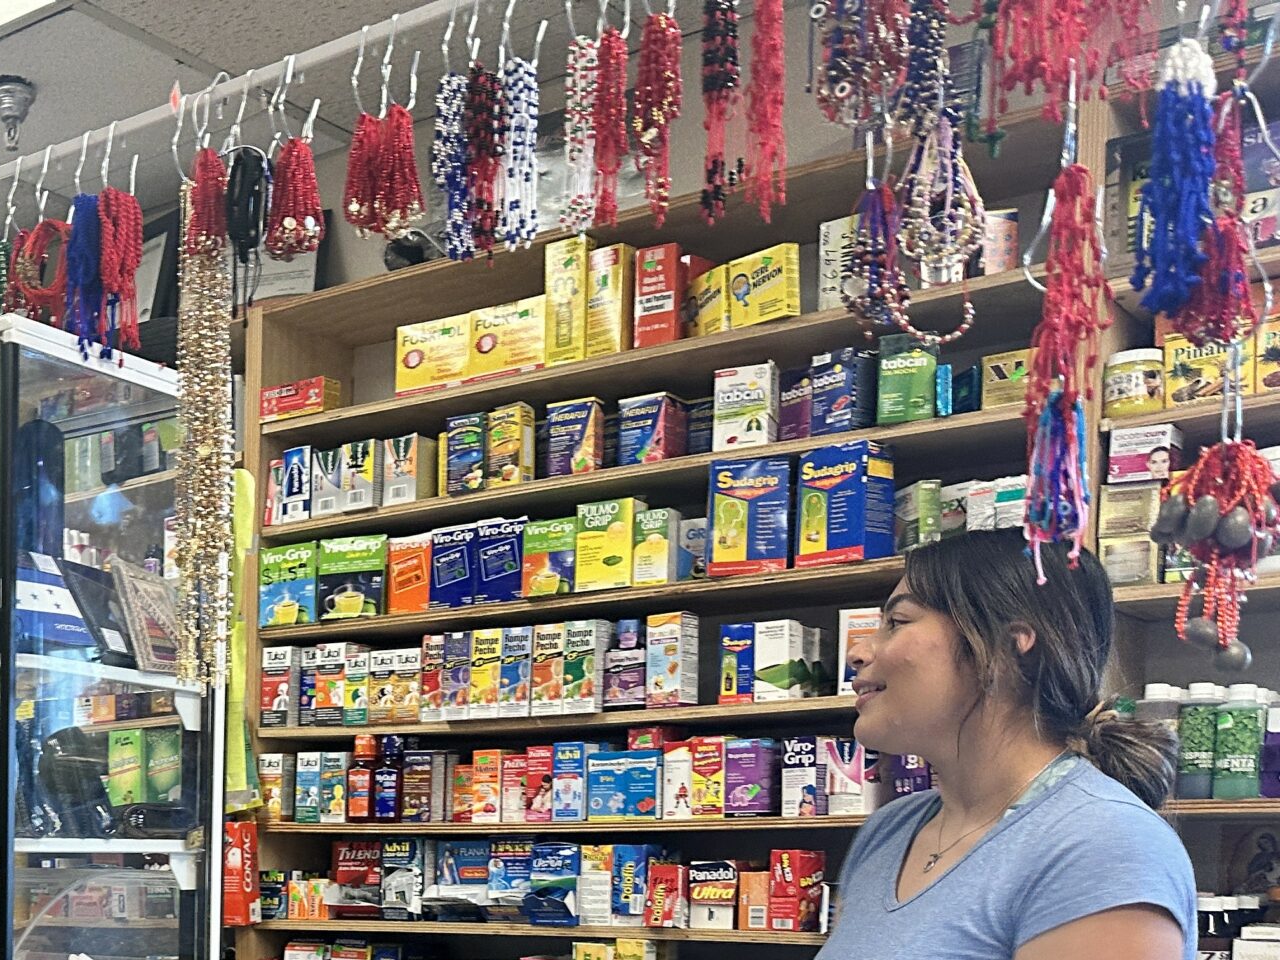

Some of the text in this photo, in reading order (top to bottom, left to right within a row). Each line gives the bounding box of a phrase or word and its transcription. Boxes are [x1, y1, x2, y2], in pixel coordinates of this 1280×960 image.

[720, 388, 764, 403] tabcin
[802, 461, 856, 481] Sudagrip
[718, 472, 779, 492] Sudagrip
[578, 504, 618, 518] PULMO
[636, 511, 668, 522] PULMO
[585, 515, 611, 528] GRIP
[640, 520, 663, 530] GRIP
[478, 523, 524, 537] Viro-Grip
[526, 524, 574, 535] Viro-Grip
[433, 530, 473, 543] Viro-Grip
[323, 539, 382, 553] Viro-Grip
[262, 548, 312, 564] Viro-Grip
[505, 633, 528, 642] Rompe
[536, 632, 561, 641] Rompe
[567, 629, 592, 638] Rompe
[475, 637, 499, 646] Rompe
[504, 642, 525, 652] Pecho
[536, 641, 558, 650] Pecho
[567, 638, 590, 648] Pecho
[475, 646, 496, 655] Pecho
[784, 739, 815, 752] Viro-
[784, 752, 814, 766] Grip
[242, 830, 253, 893] CONTAC
[689, 867, 734, 881] Panadol
[692, 887, 735, 900] Ultra
